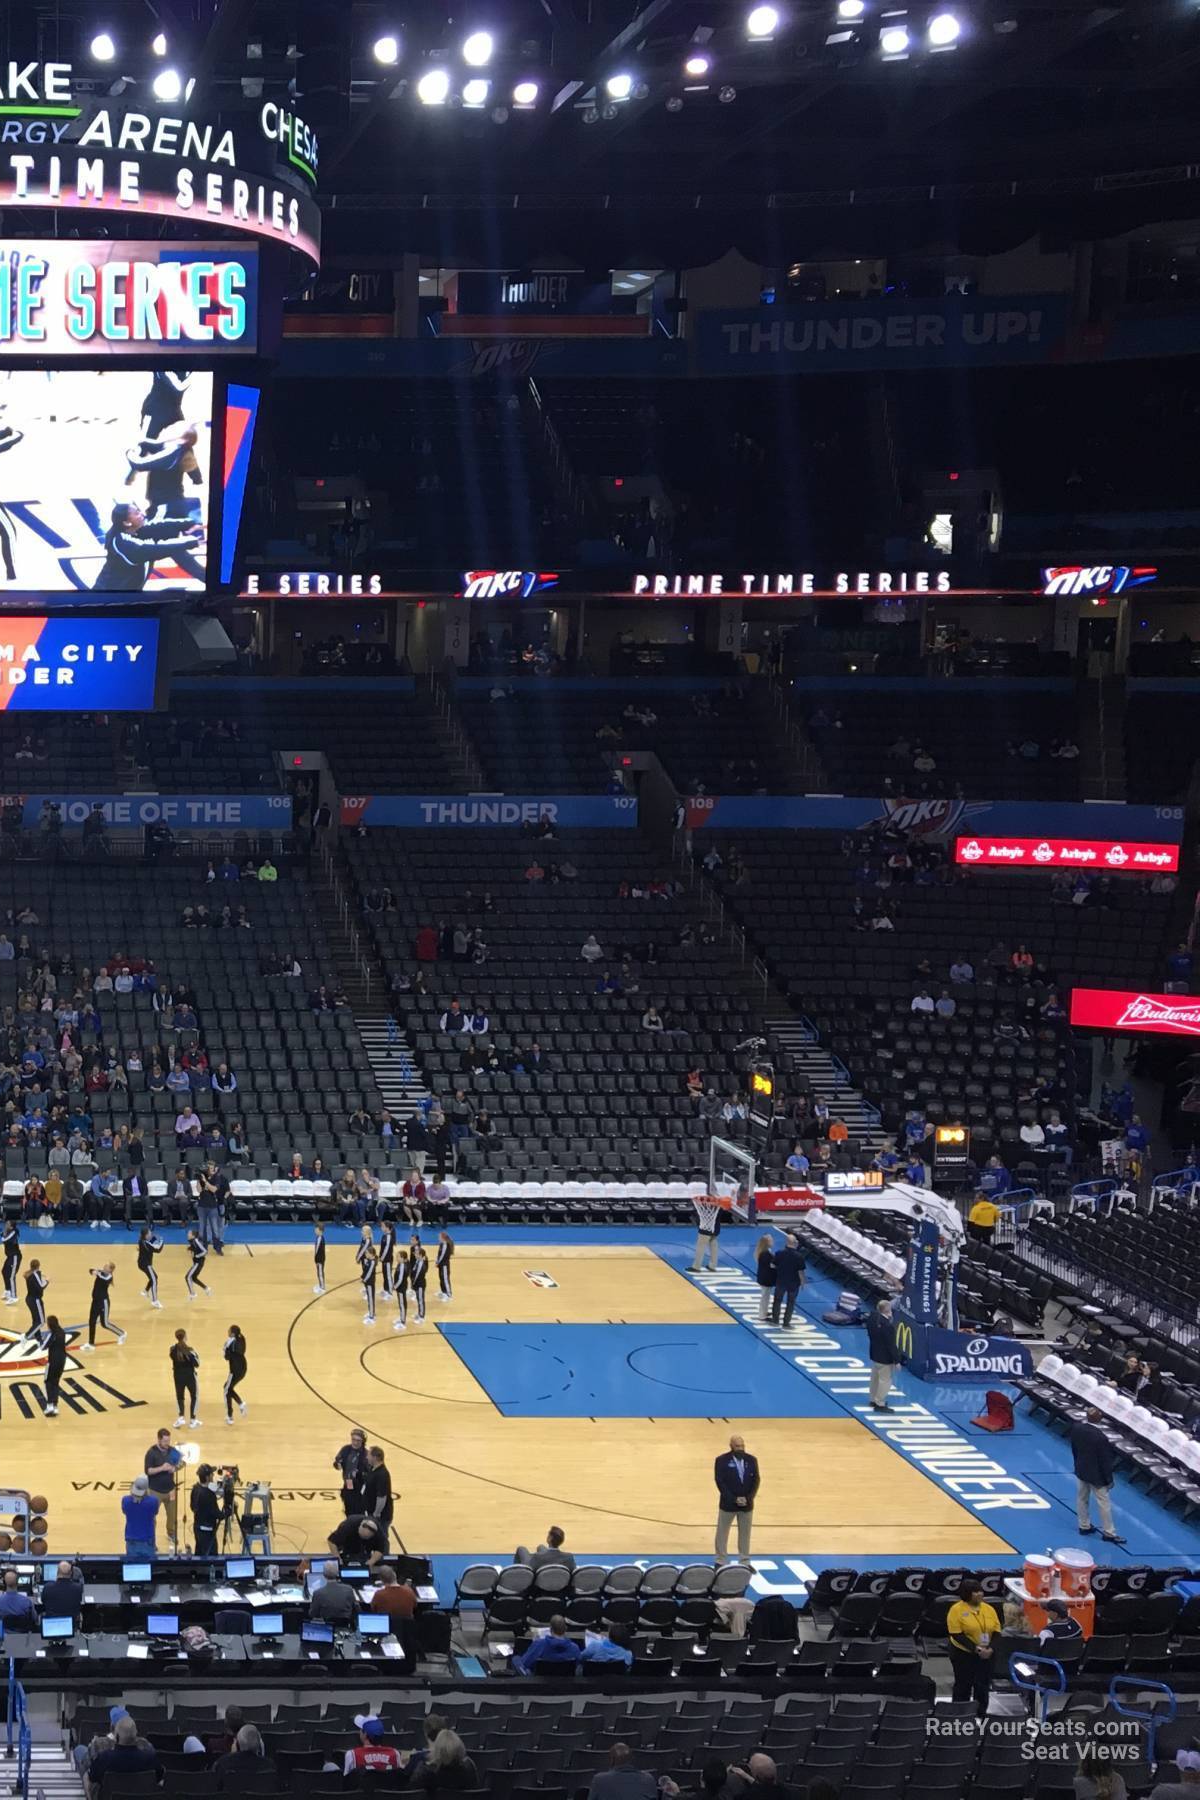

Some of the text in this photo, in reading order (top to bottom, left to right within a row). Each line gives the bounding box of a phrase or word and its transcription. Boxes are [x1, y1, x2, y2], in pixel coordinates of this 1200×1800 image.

[77, 110, 236, 168] ARENA
[10, 155, 140, 201] TIME
[176, 168, 299, 237] SERIES
[65, 261, 247, 341] SERIES
[501, 276, 568, 304] THUNDER
[722, 310, 1043, 354] THUNDER UP!
[279, 572, 382, 595] SERIES
[464, 572, 522, 598] OKC
[634, 571, 950, 595] PRIME TIME SERIES
[1044, 567, 1114, 594] OKC
[61, 643, 145, 663] CITY
[139, 801, 180, 823] OF
[182, 801, 242, 823] THE
[267, 797, 291, 808] 106
[342, 797, 366, 808] 107
[420, 802, 559, 824] THUNDER
[613, 797, 637, 808] 107
[690, 797, 714, 809] 108
[1154, 807, 1183, 820] 108
[989, 846, 1025, 858] Arby's
[1060, 848, 1097, 861] Arby's
[1134, 851, 1173, 865] Arby's
[827, 1172, 883, 1187] ENDUI
[922, 1256, 932, 1313] DRAFTKINGS
[936, 1353, 1025, 1376] SPALDING
[854, 1403, 1052, 1511] THUNDER
